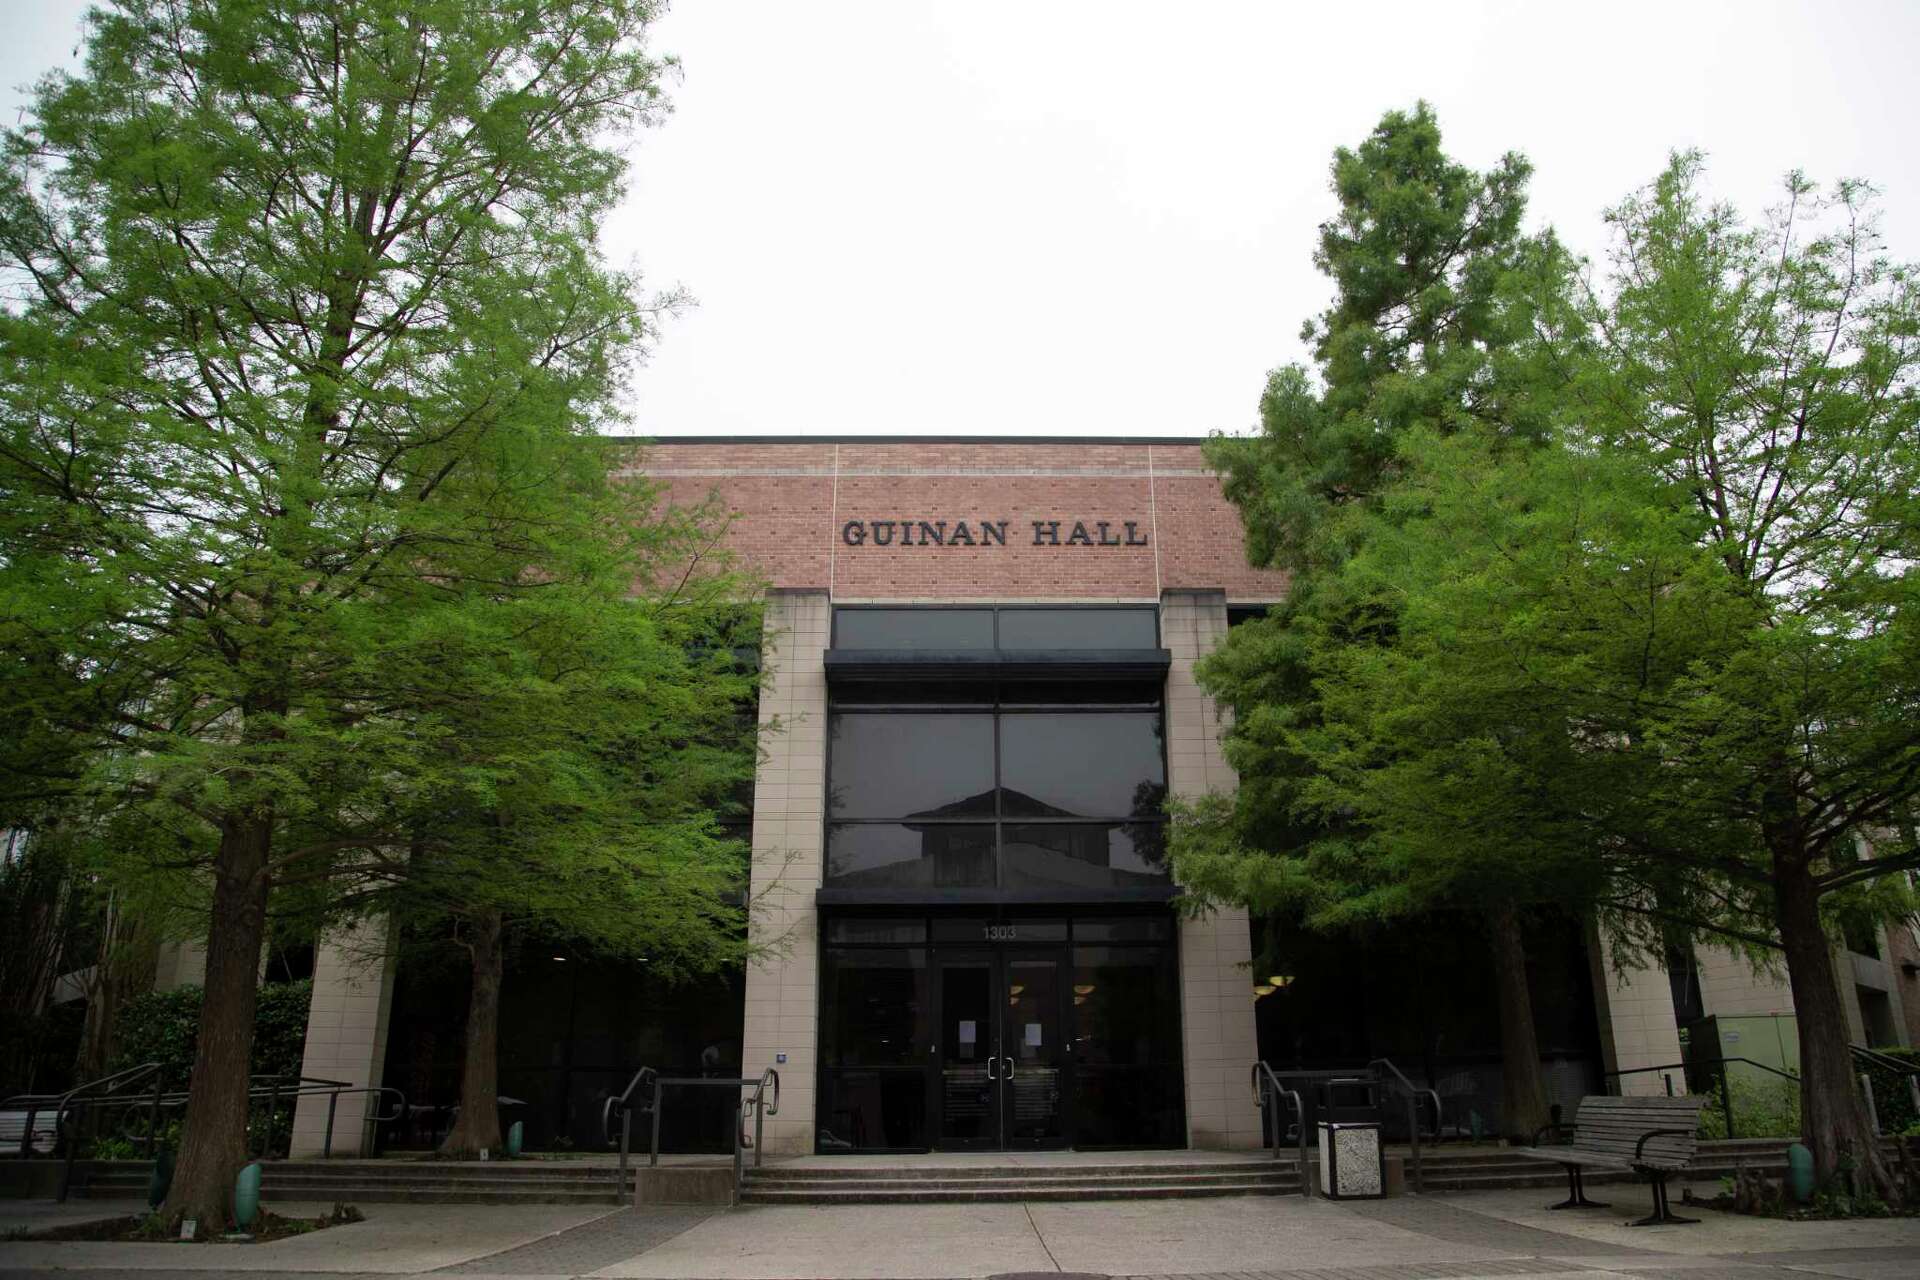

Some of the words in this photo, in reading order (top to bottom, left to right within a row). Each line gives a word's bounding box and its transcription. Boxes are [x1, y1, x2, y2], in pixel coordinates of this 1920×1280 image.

[842, 521, 1009, 546] GUINAN
[1031, 521, 1148, 546] HALL
[983, 925, 1016, 940] 1303
